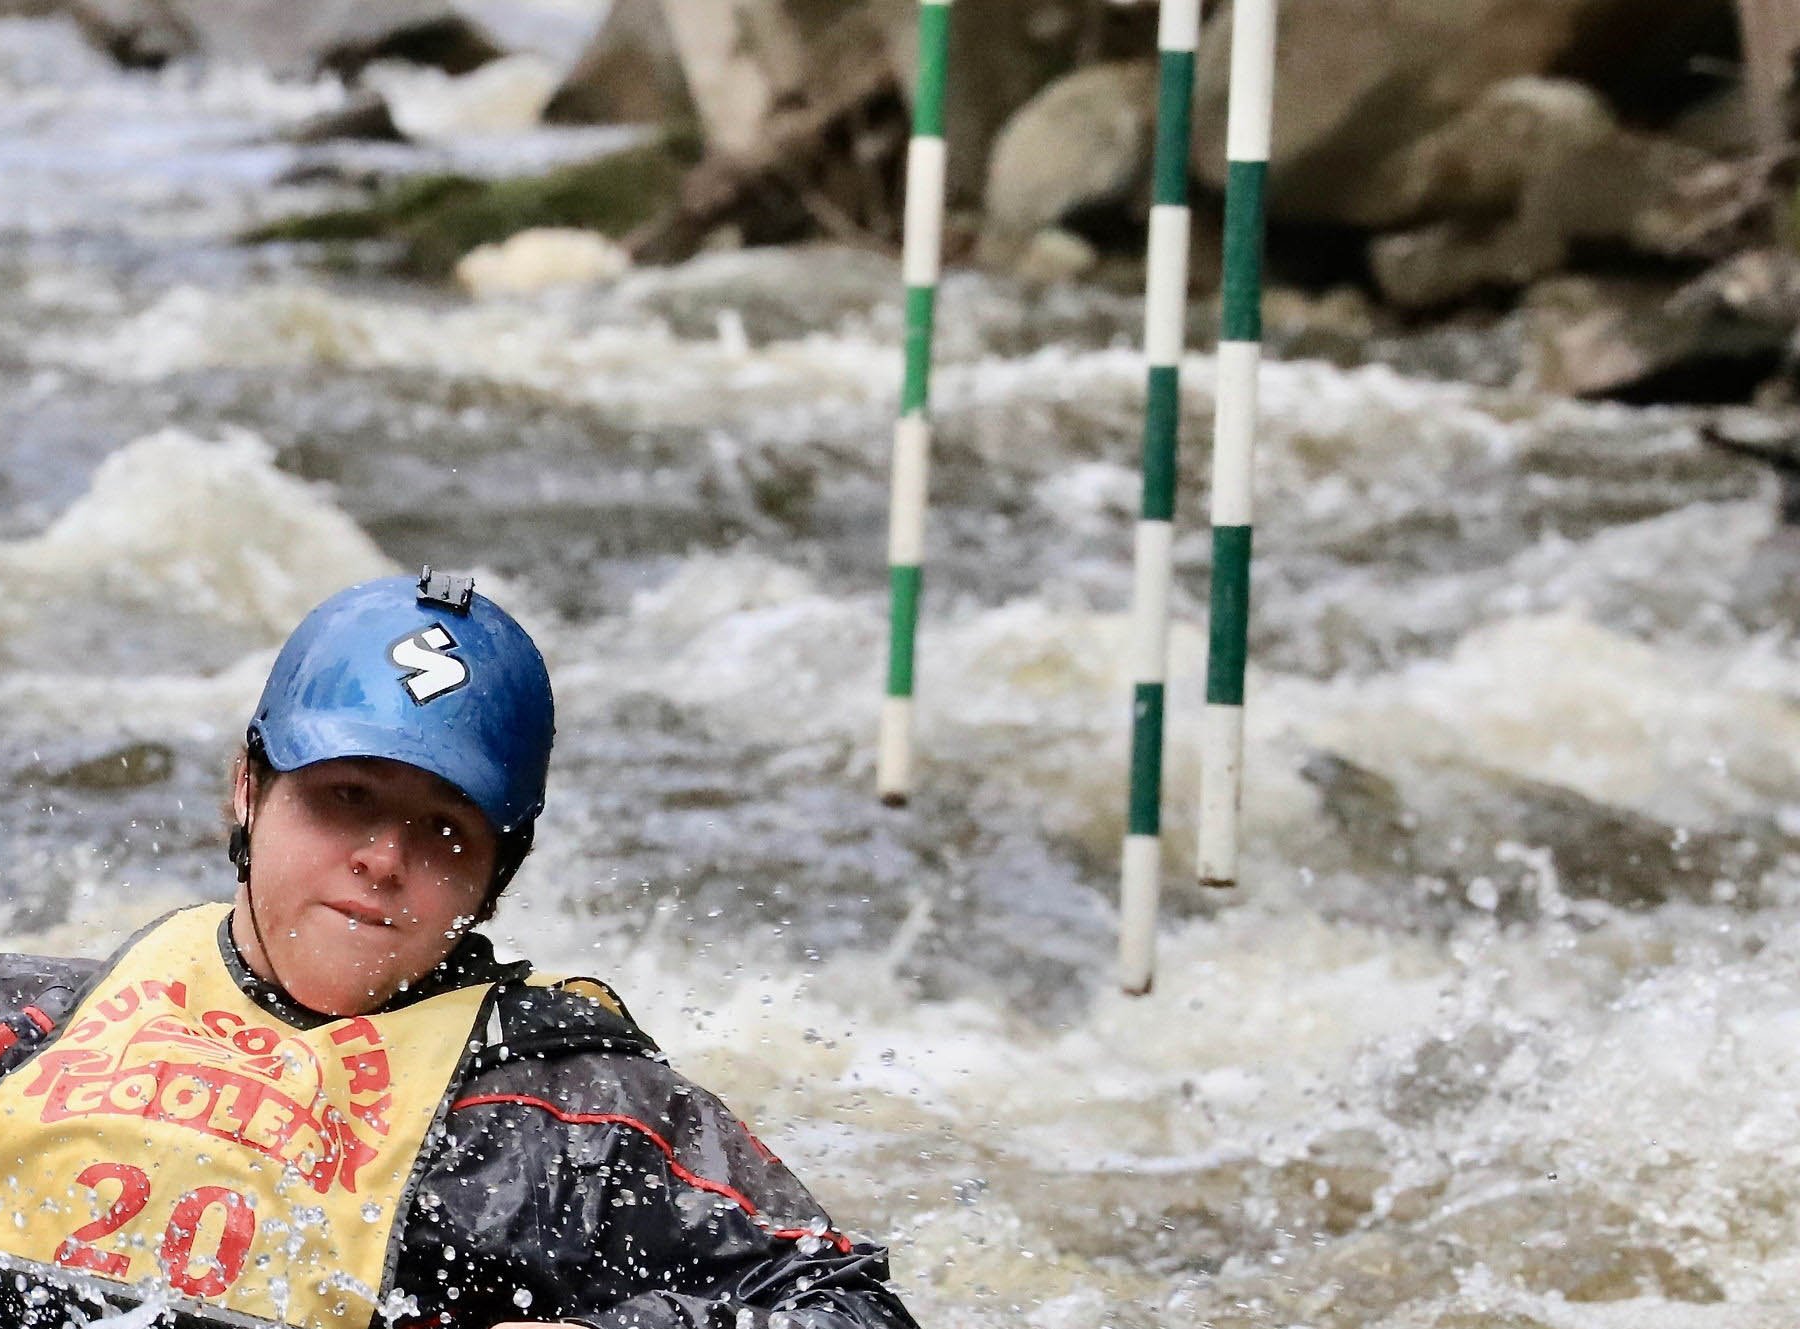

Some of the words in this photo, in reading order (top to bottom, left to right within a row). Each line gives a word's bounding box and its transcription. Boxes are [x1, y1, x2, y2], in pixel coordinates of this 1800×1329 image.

[61, 978, 188, 1044] SUN
[64, 1072, 326, 1177] COOLER
[53, 1161, 256, 1298] 20
